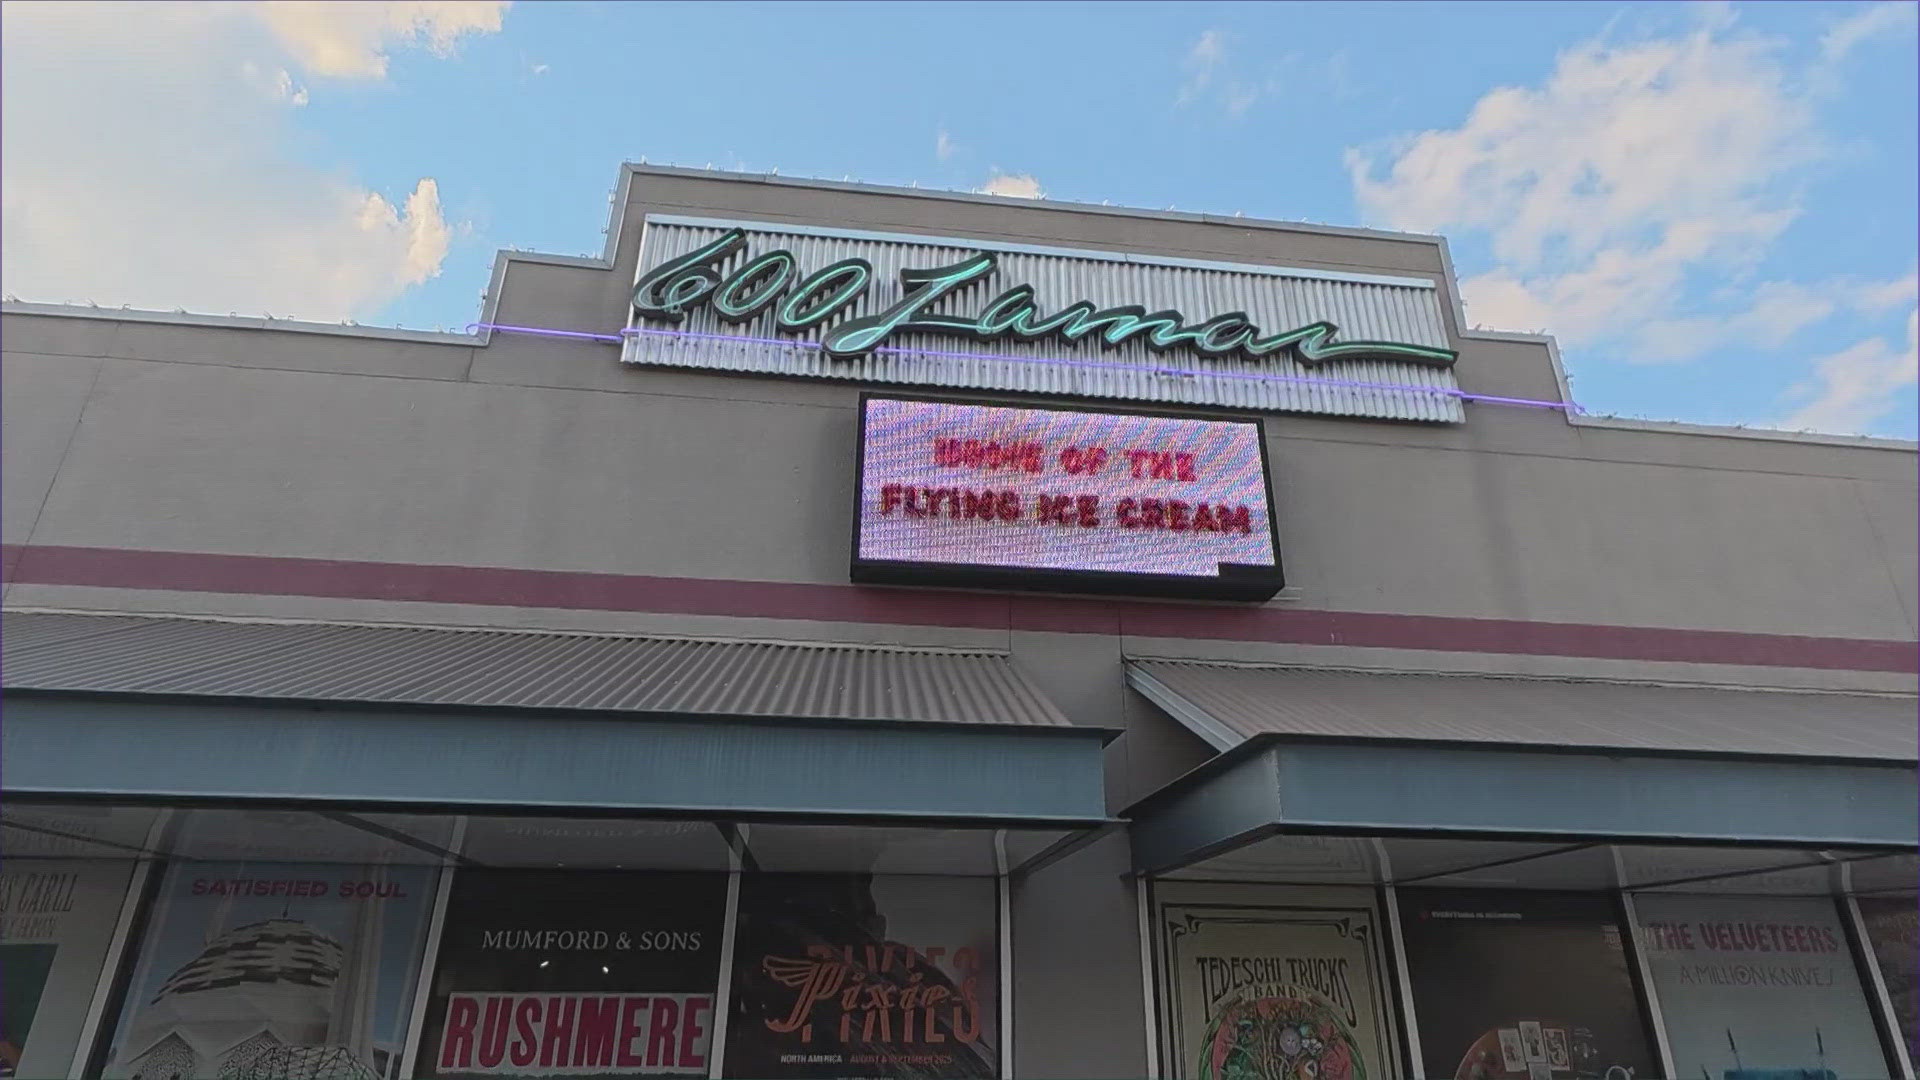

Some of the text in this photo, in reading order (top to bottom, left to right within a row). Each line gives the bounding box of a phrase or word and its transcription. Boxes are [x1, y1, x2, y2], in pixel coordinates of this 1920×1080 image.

[632, 228, 1458, 360] 600 Lamar
[1060, 445, 1108, 476] OF
[1125, 448, 1197, 482] THE
[881, 483, 1251, 534] FLYING ICE CREAM
[192, 879, 407, 898] SATISFIED SOUL
[481, 930, 702, 951] MUMFORD & SONS
[1650, 922, 1695, 950] THE
[1700, 923, 1838, 952] VELVETEERS
[1196, 957, 1357, 1028] TEDESCHI TRUCKS
[1680, 966, 1694, 984] A
[1696, 966, 1767, 986] MILLION
[441, 996, 711, 1068] RUSHMERE
[780, 1055, 806, 1063] NORTH
